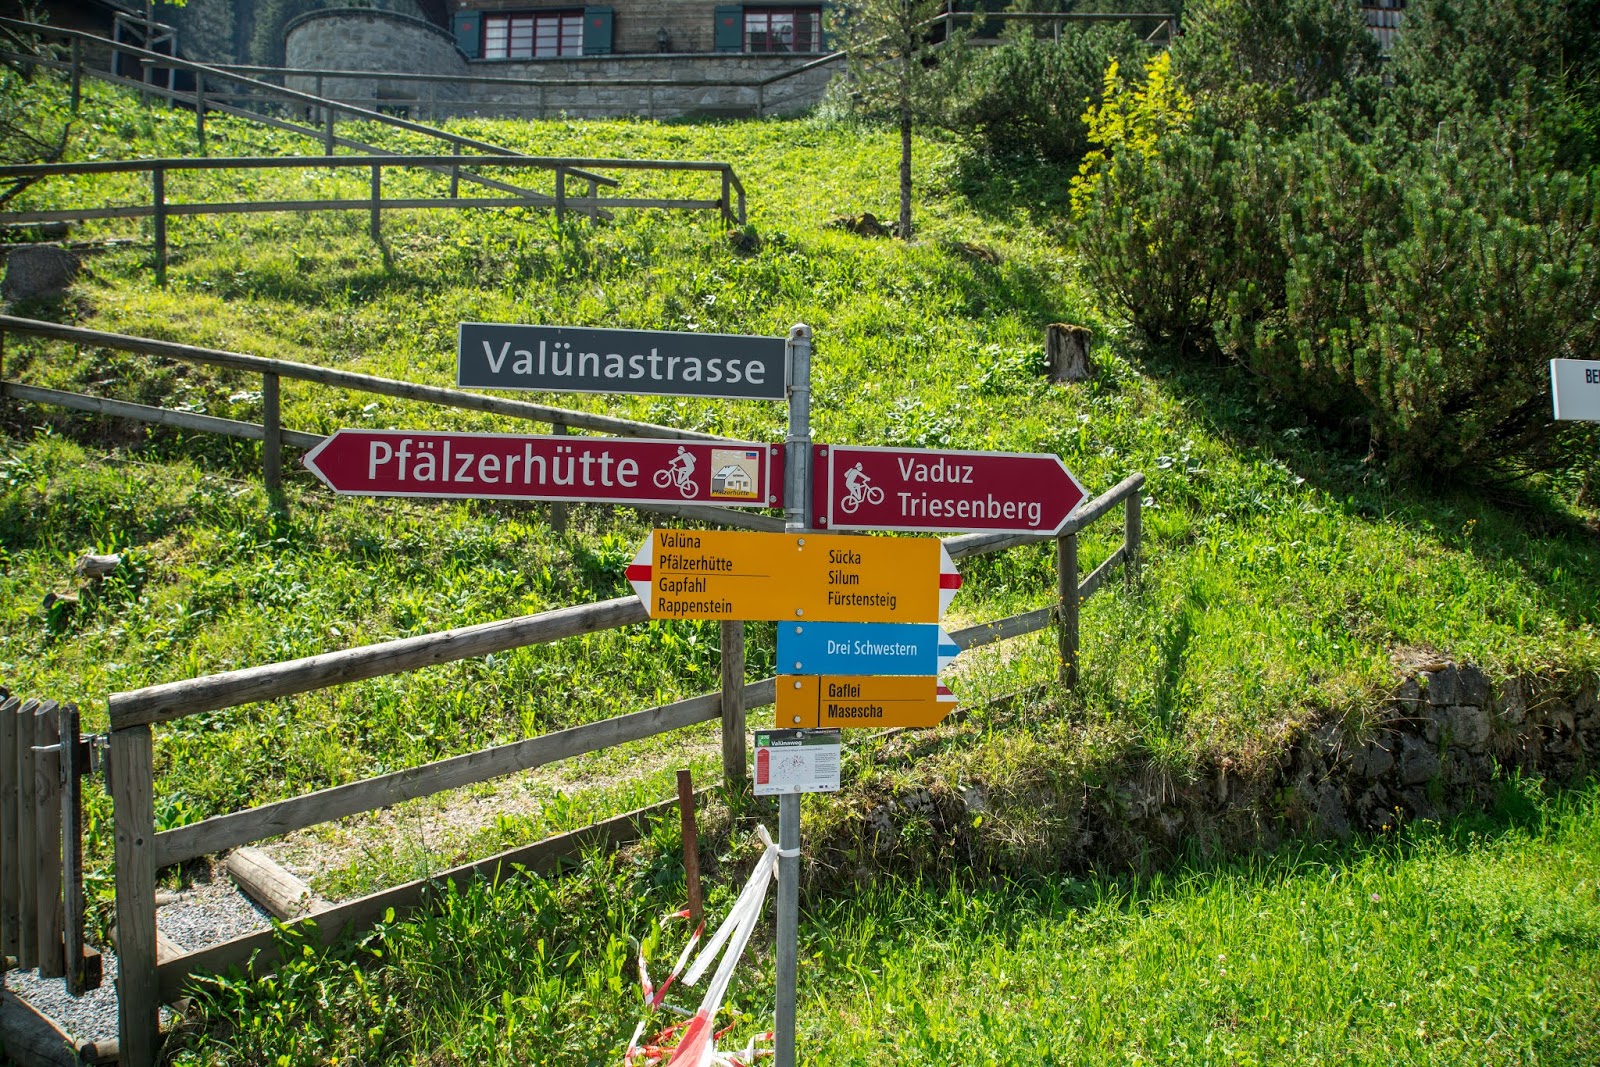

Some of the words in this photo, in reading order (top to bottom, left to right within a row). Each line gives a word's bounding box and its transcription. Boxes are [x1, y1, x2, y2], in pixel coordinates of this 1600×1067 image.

[482, 340, 766, 384] Valünastrasse
[368, 439, 639, 487] Pfälzerhütte
[897, 457, 974, 484] Vaduz
[897, 492, 1041, 527] Triesenberg
[660, 533, 701, 548] Valüna
[660, 554, 733, 571] Pfälzerhütte
[829, 550, 861, 565] Sücka
[659, 577, 706, 596] Gapfahl
[828, 570, 859, 585] Silum
[658, 597, 732, 616] Rappenstein
[828, 591, 897, 610] Fürstensteig
[827, 640, 851, 655] Drei
[854, 640, 917, 656] Schwestern
[828, 684, 861, 698] Gaflei
[828, 704, 883, 718] Masescha
